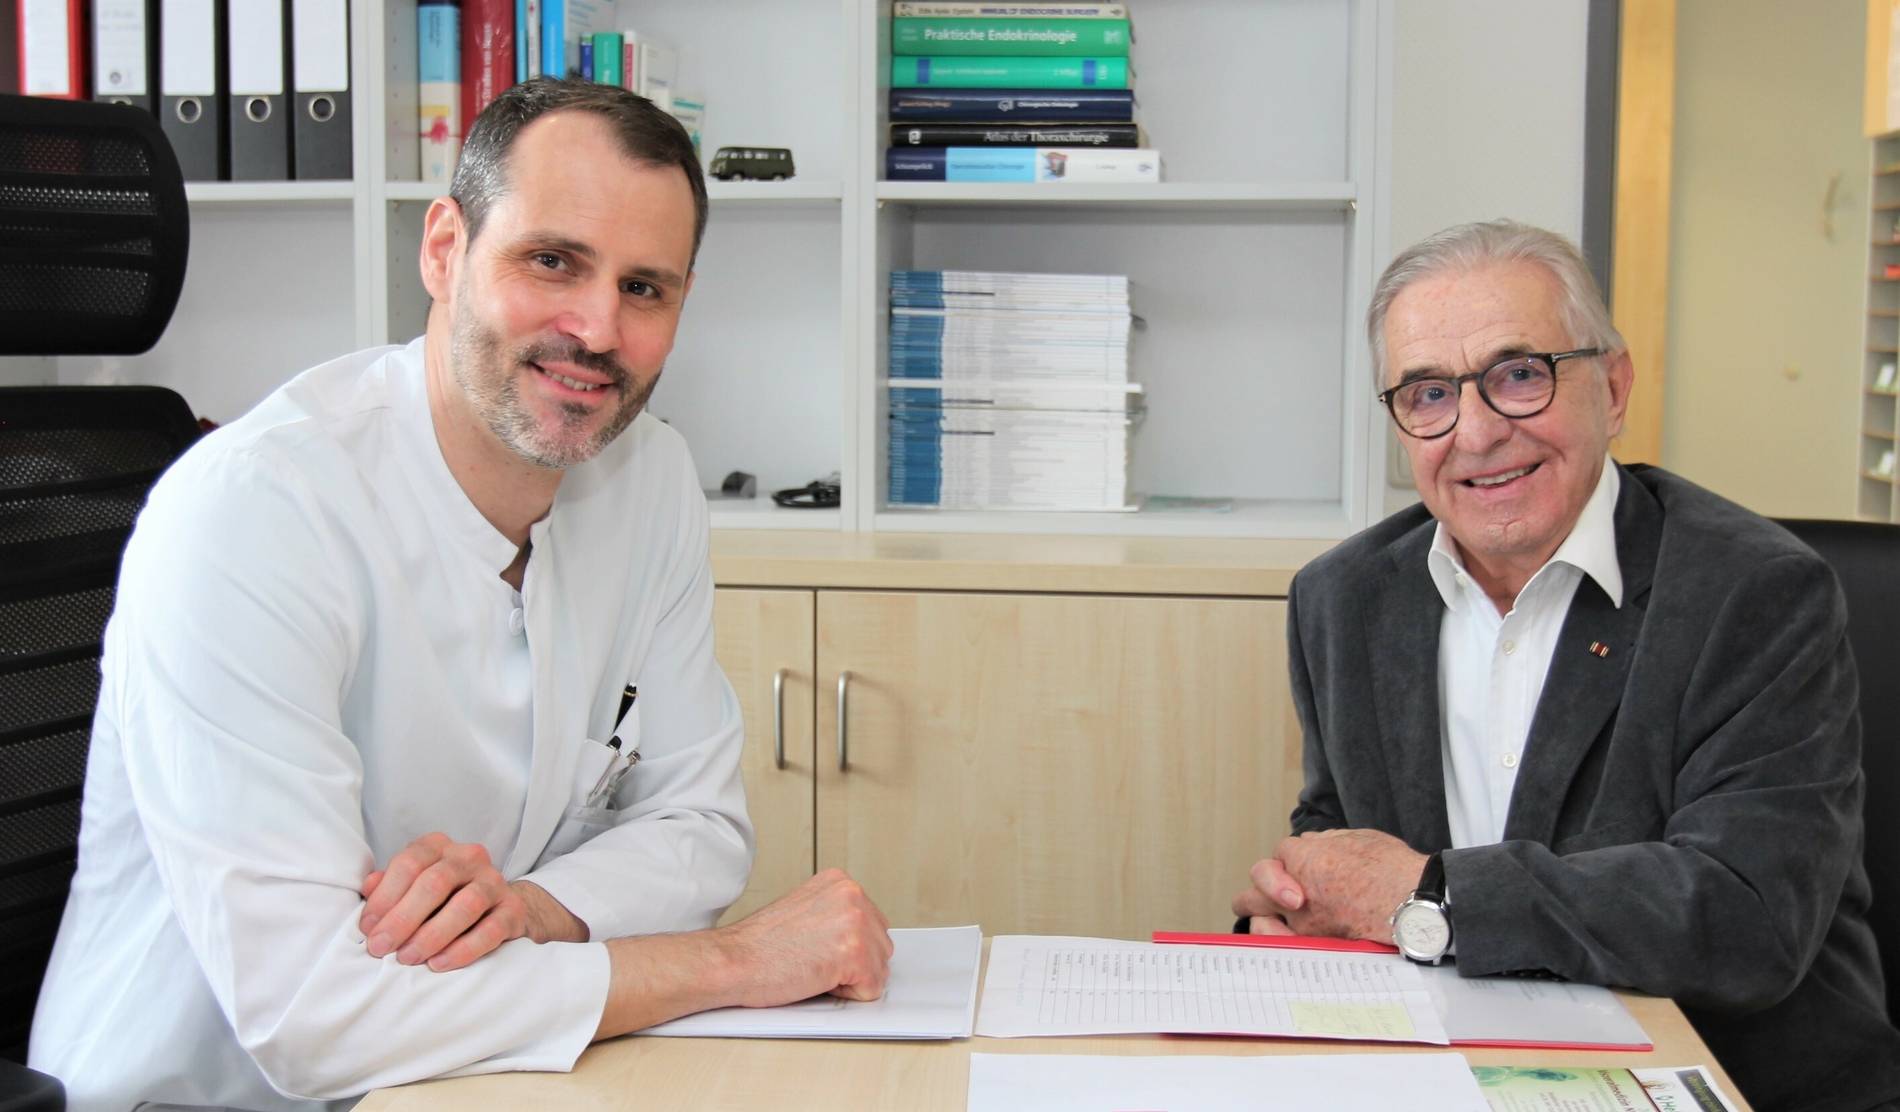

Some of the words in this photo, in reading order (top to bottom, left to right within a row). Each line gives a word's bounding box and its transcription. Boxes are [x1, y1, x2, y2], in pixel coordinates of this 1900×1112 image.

[924, 28, 984, 41] Praktische
[987, 28, 1077, 44] Endokrinologie
[984, 131, 1009, 142] Atlas
[1011, 131, 1028, 142] der
[1030, 131, 1110, 146] Thoraxchirurgie
